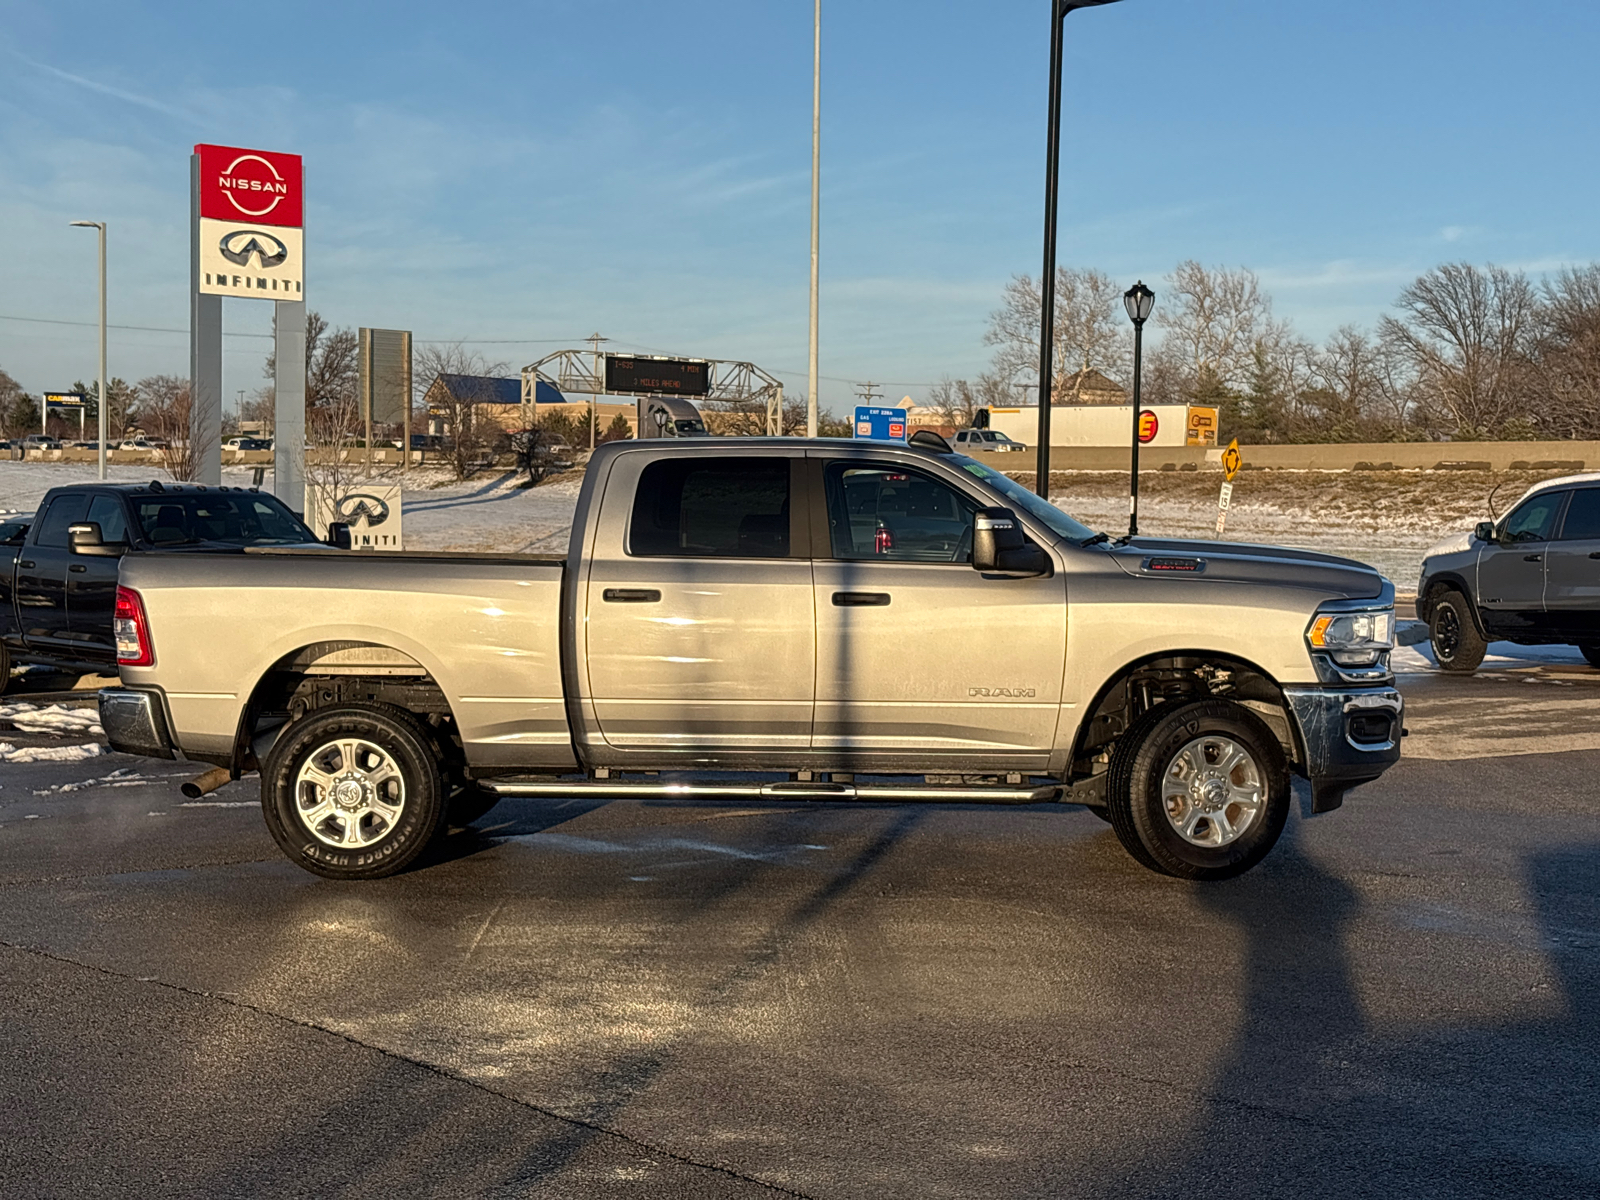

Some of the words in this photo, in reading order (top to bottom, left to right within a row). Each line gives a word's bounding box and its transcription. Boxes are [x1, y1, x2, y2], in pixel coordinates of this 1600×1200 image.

[219, 177, 287, 193] NISSAN
[206, 273, 301, 292] INFINITI
[640, 378, 660, 387] MILES
[661, 379, 681, 388] AHEAD
[324, 535, 396, 545] IINITI
[969, 687, 1035, 698] RAM
